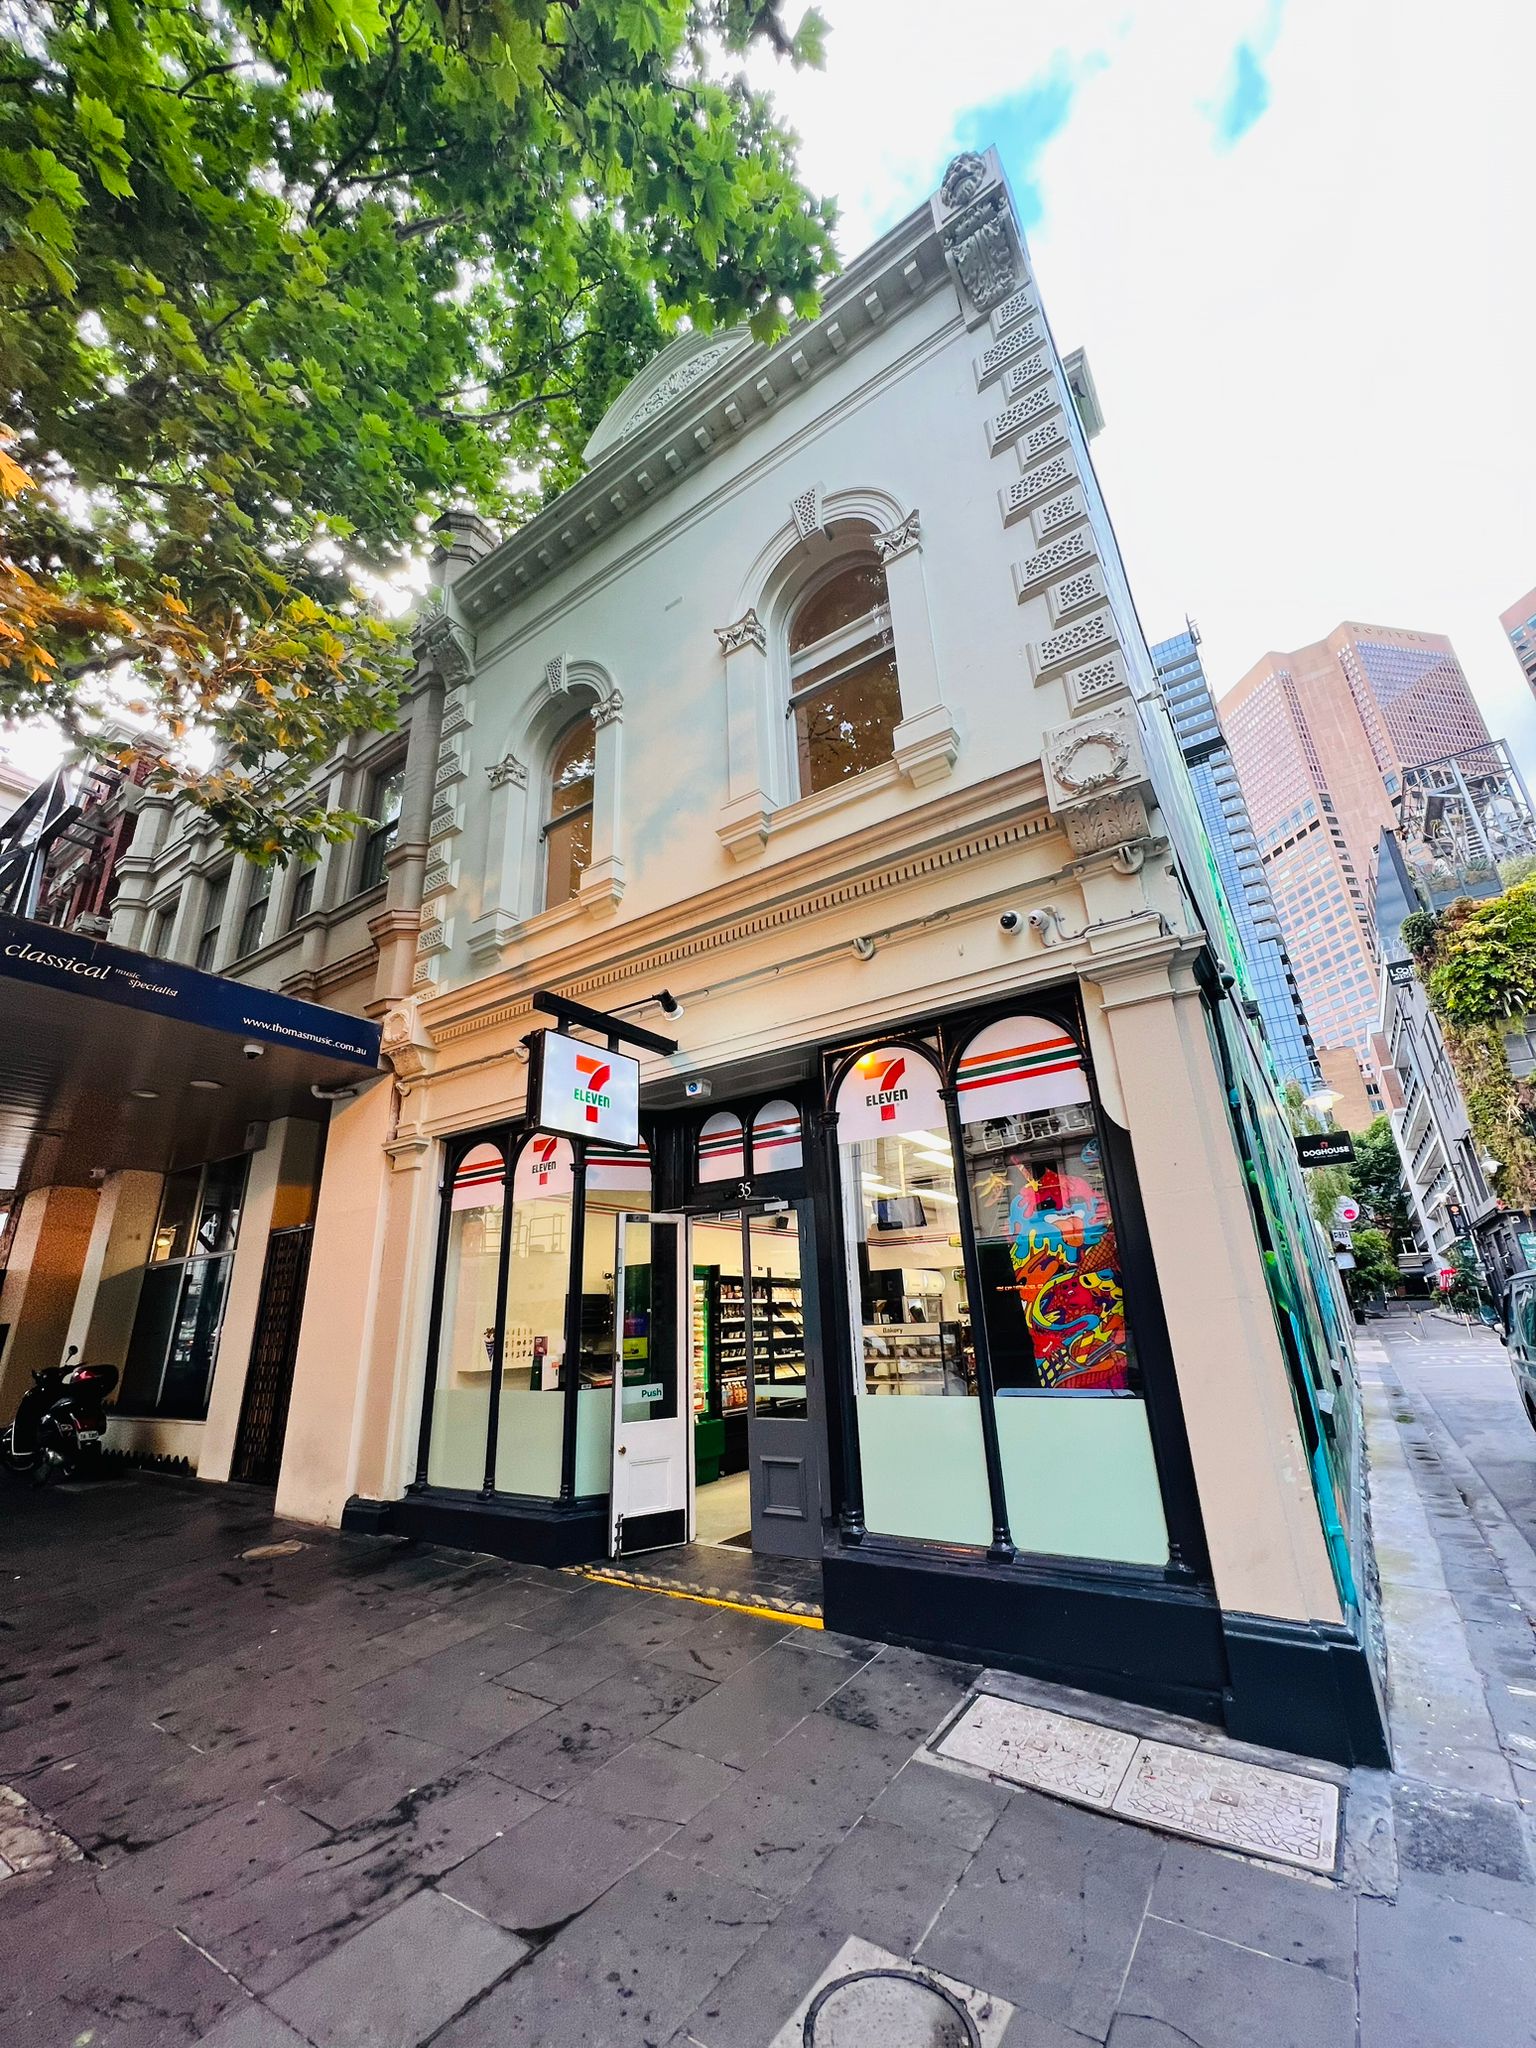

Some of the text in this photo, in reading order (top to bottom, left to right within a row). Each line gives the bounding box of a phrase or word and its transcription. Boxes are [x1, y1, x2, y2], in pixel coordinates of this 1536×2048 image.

[5, 943, 112, 980] classical
[115, 968, 141, 979] music
[128, 978, 179, 997] specialist
[243, 1017, 367, 1055] www.thomasmusic.com.au
[575, 1054, 611, 1123] 7
[864, 1057, 905, 1121] 7
[533, 1136, 558, 1186] 7
[1302, 1145, 1350, 1158] DOGHOUSE
[738, 1181, 751, 1198] 35
[641, 1387, 662, 1398] Push
